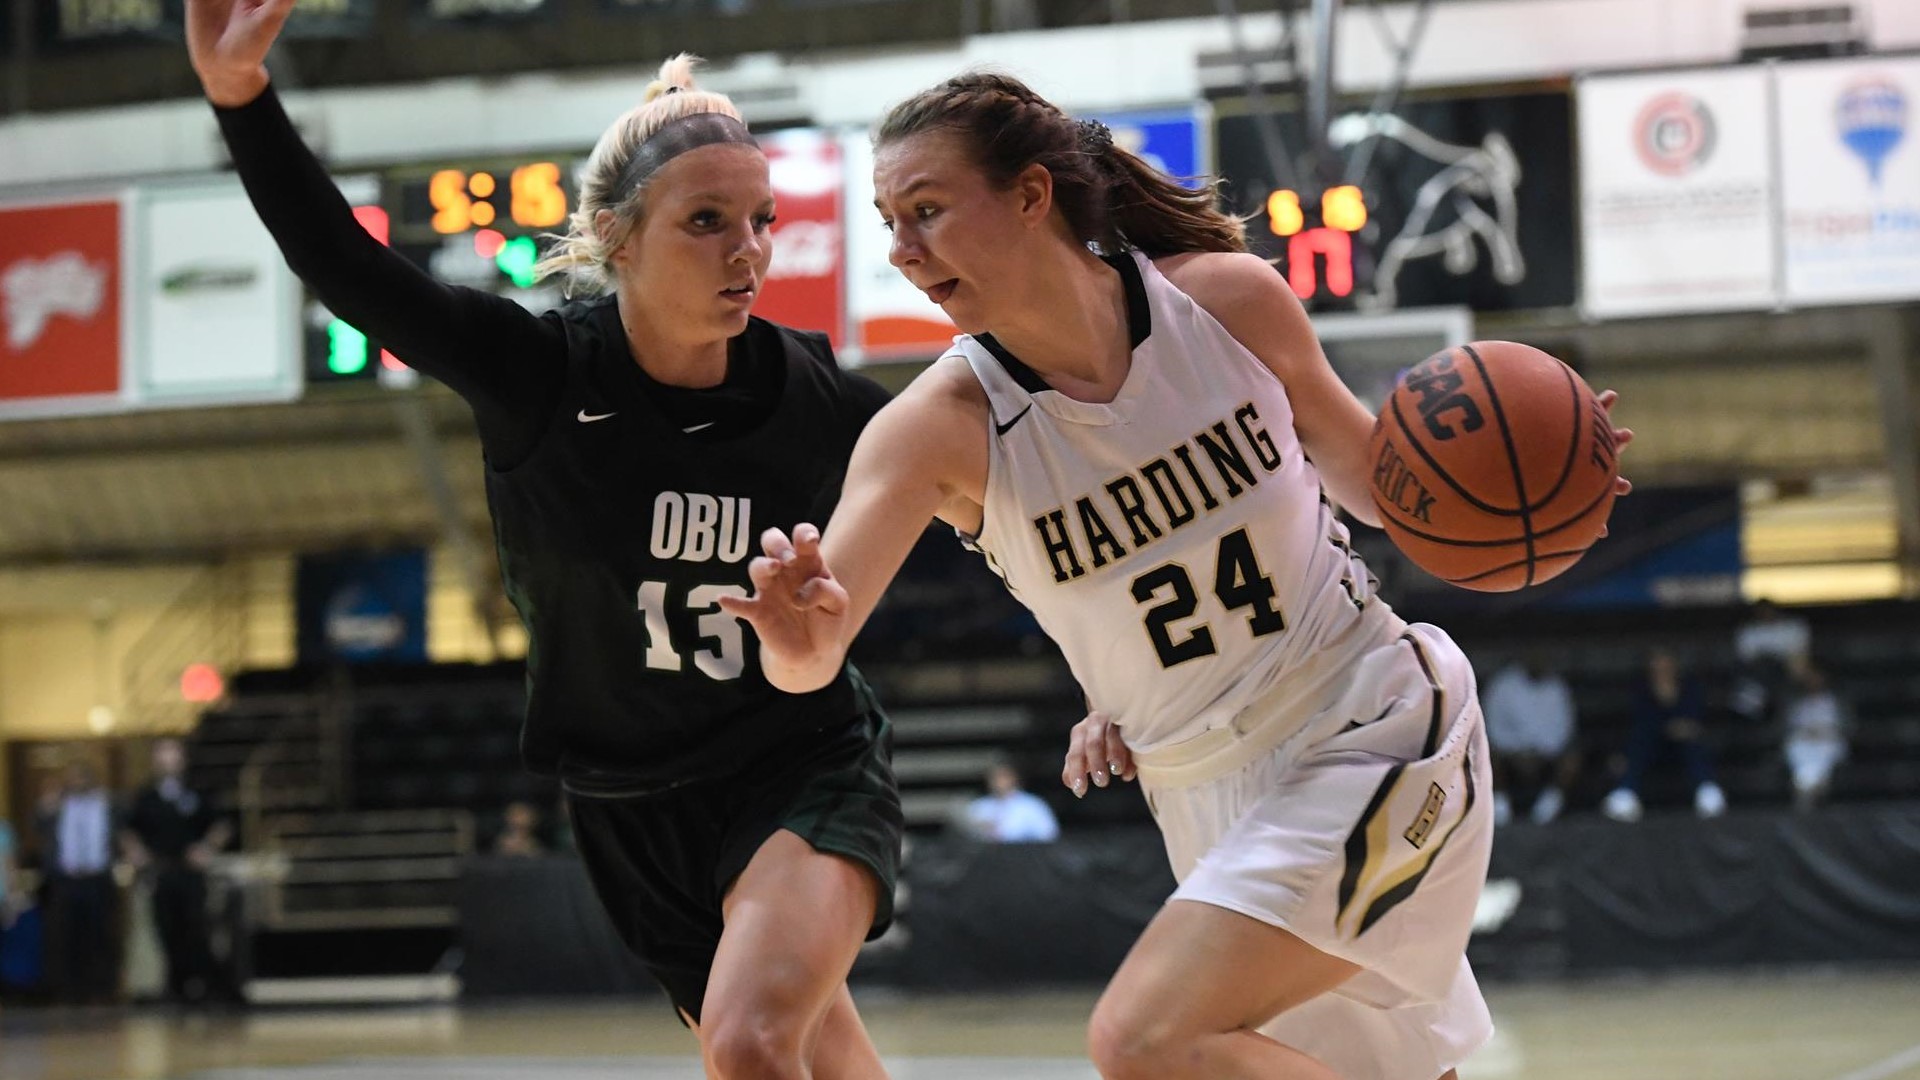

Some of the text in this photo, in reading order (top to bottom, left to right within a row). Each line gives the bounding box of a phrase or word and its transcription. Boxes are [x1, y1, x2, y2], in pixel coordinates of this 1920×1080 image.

[650, 490, 751, 564] OBU
[1033, 401, 1283, 584] HARDING
[637, 580, 748, 681] 13
[1130, 525, 1287, 669] 24
